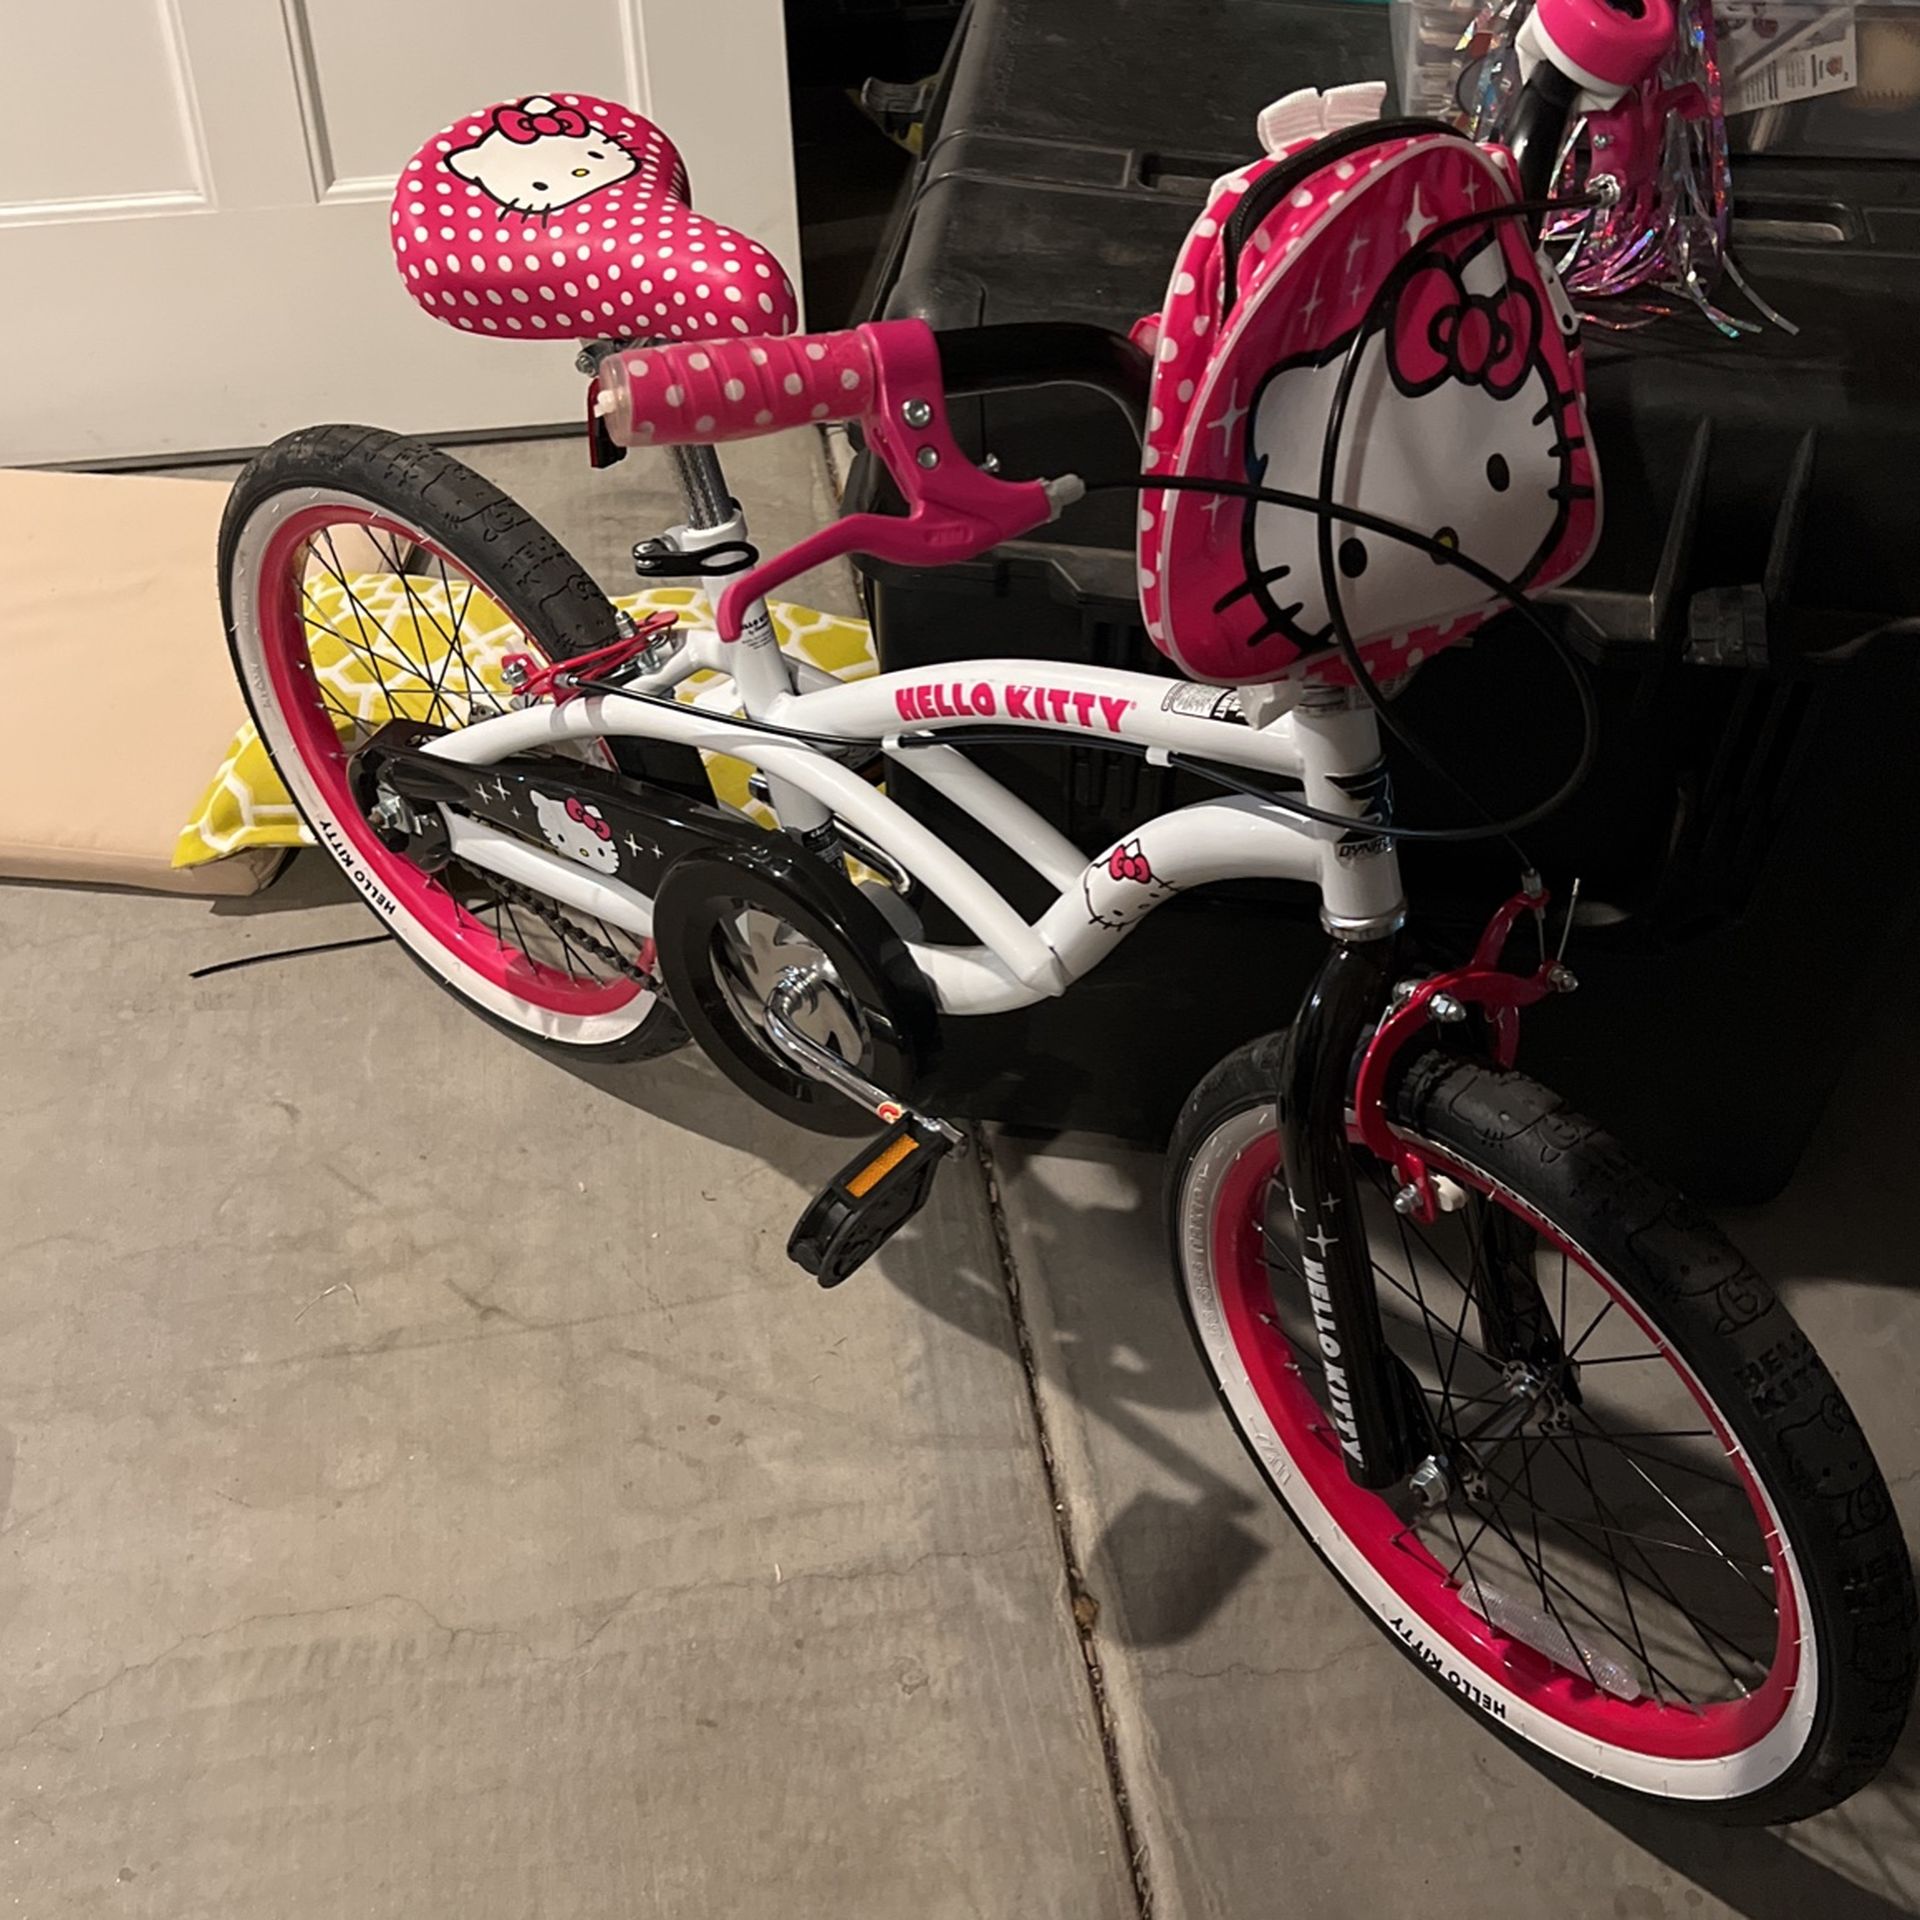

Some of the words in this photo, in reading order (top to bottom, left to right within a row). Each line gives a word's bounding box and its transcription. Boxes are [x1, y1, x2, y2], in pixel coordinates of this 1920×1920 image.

[895, 683, 996, 721] HELLO
[1005, 684, 1131, 733] KITTY
[319, 820, 355, 868] KITTY
[354, 870, 397, 915] HELLO
[1302, 1255, 1342, 1359] HELLO
[1323, 1359, 1366, 1467] KITTY
[1388, 1617, 1444, 1672] KITTY
[1447, 1671, 1507, 1719] HELLO
